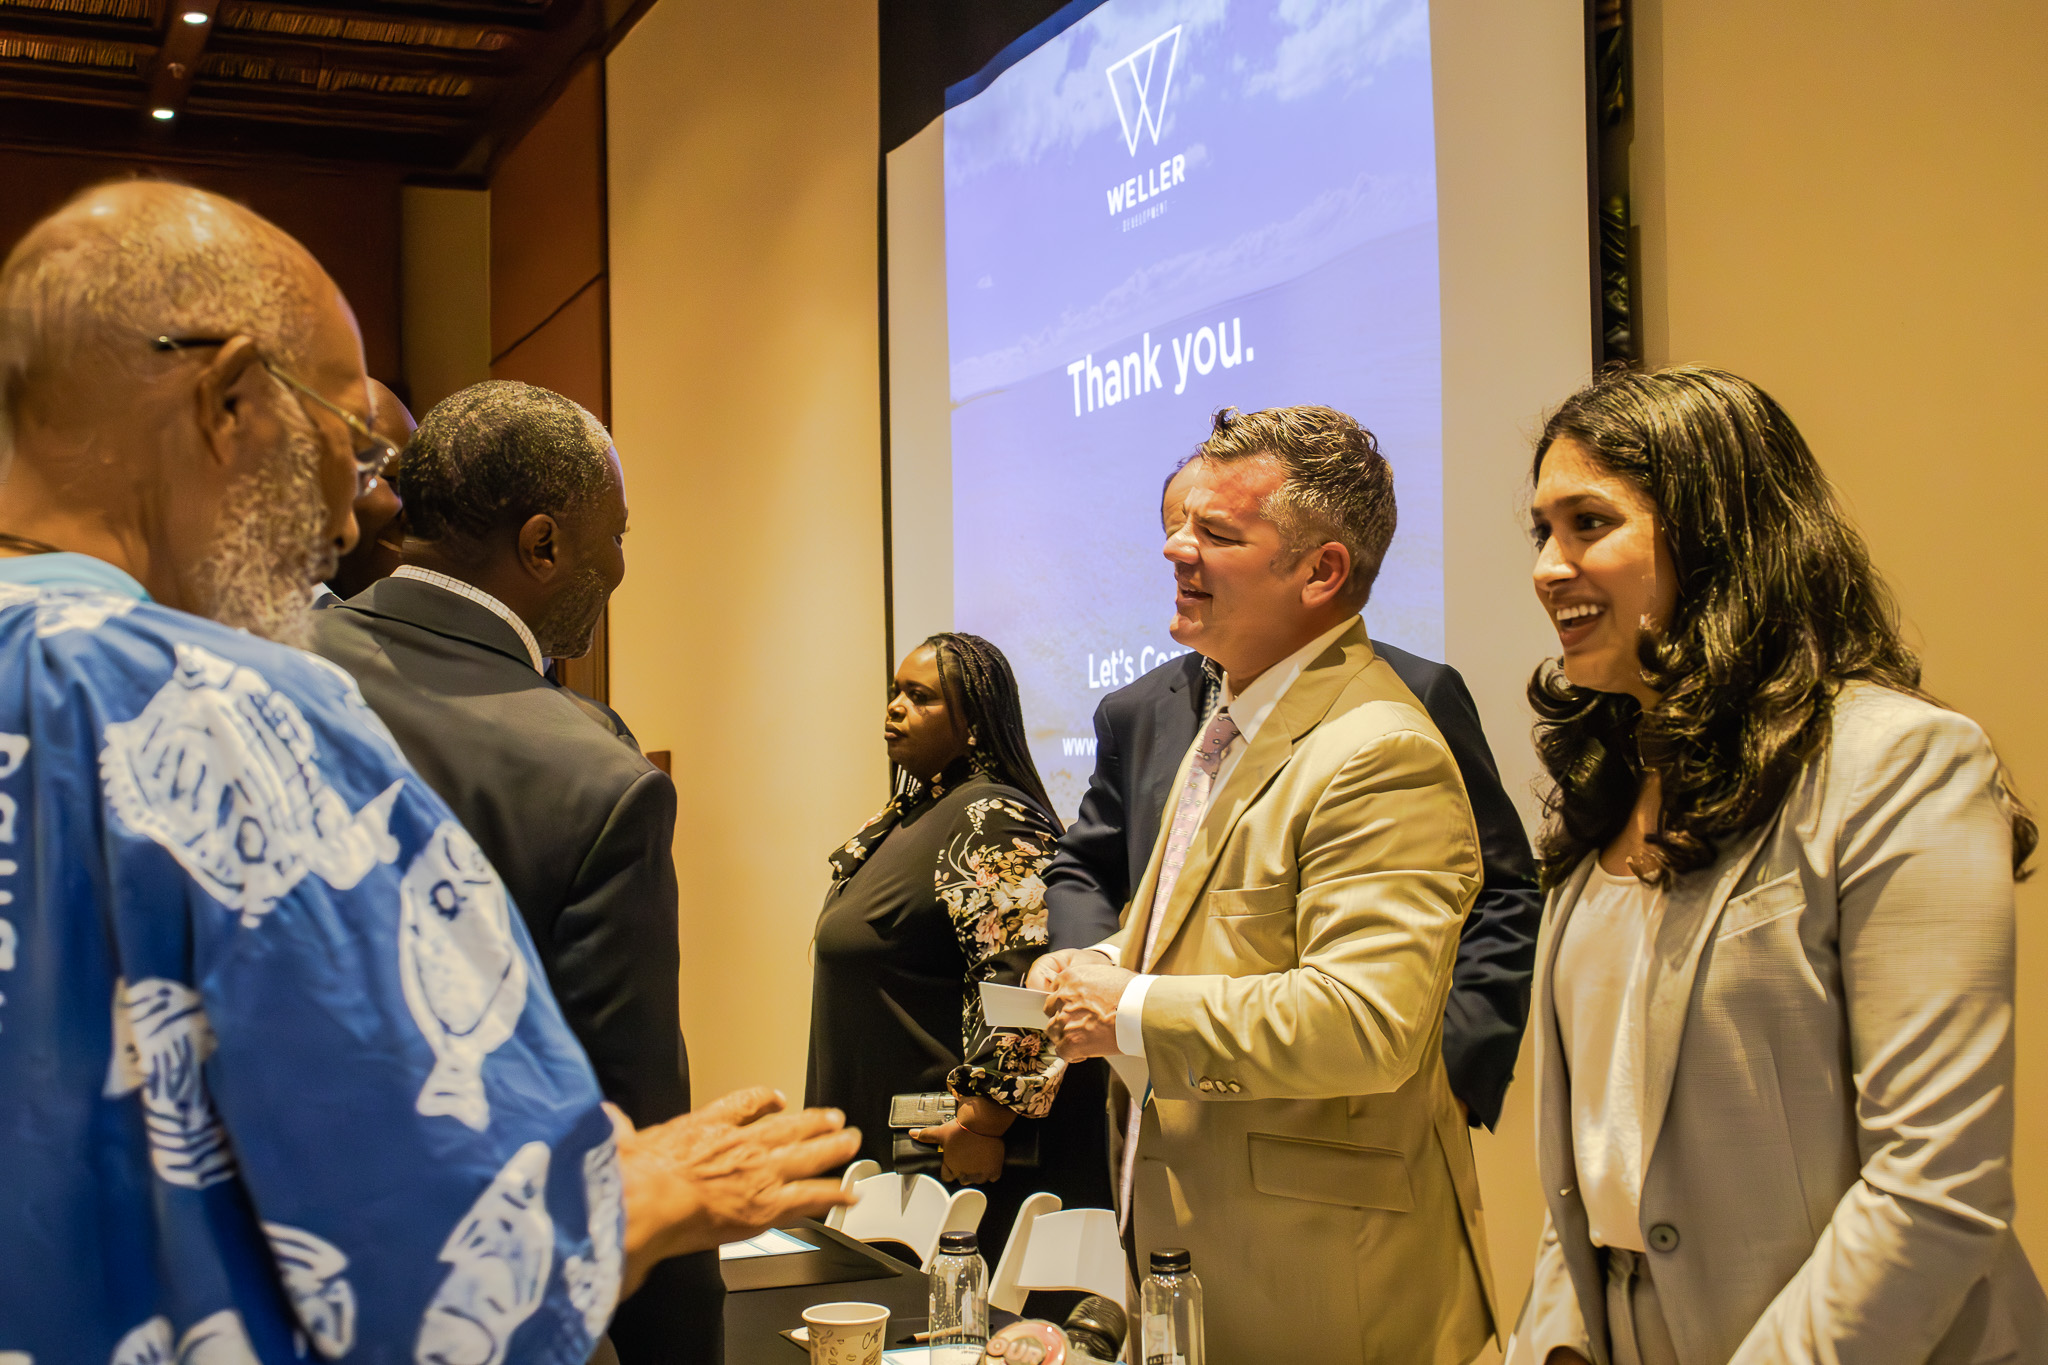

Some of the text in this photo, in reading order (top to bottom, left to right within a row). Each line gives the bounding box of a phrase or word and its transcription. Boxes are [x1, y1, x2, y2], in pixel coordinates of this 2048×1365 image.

[1107, 153, 1186, 216] WELLER
[1067, 317, 1255, 418] Thank you.
[1088, 648, 1135, 689] Let's
